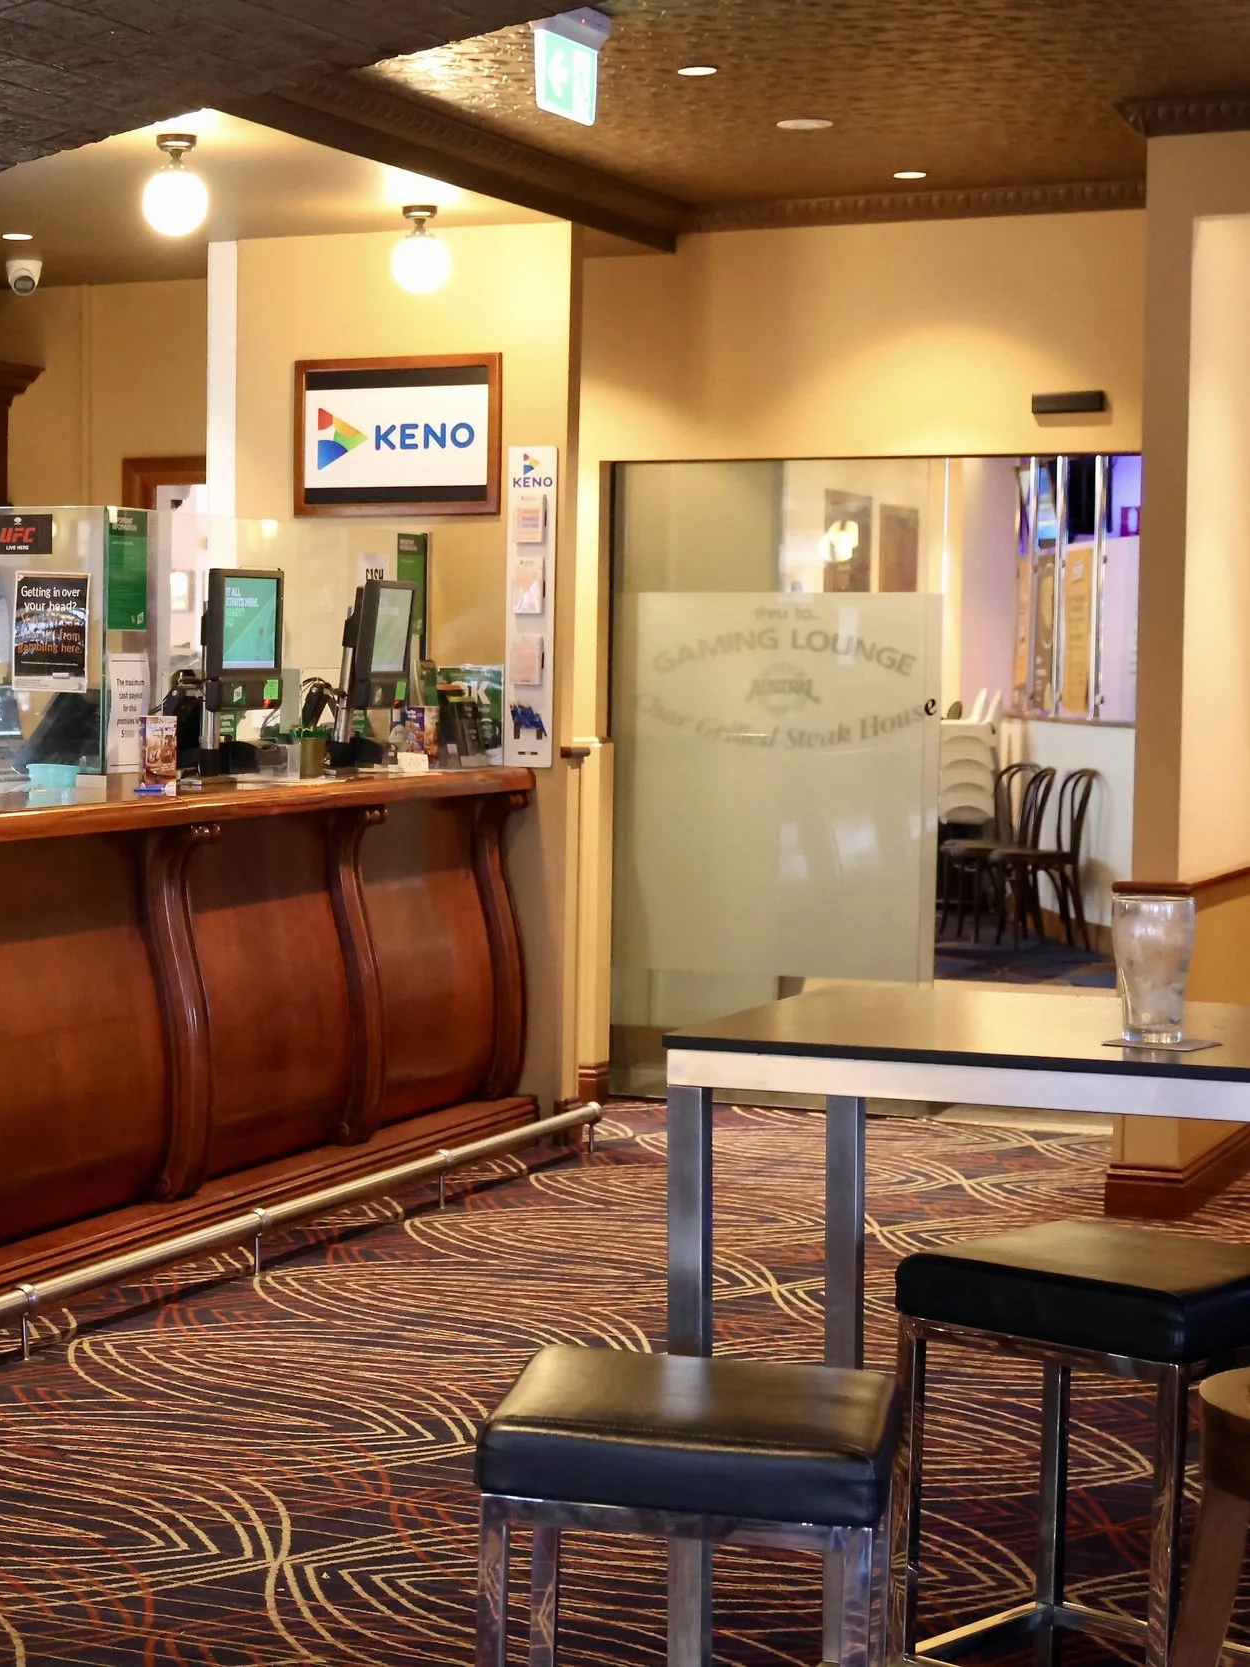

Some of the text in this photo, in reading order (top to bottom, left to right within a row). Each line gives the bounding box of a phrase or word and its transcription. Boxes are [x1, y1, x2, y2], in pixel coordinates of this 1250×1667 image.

[375, 422, 475, 451] KENO
[512, 477, 553, 488] KENO
[20, 585, 81, 599] Getting in over
[231, 588, 241, 597] ALL
[24, 600, 78, 612] your head?
[225, 598, 244, 607] STARTS
[59, 628, 80, 642] from
[17, 643, 82, 654] gambling here.
[652, 627, 917, 677] GAMING LOUNGE
[116, 678, 124, 686] The
[118, 692, 143, 700] cash payout
[129, 704, 137, 712] this
[116, 718, 136, 727] premises
[784, 722, 852, 750] Steak
[859, 698, 938, 742] House
